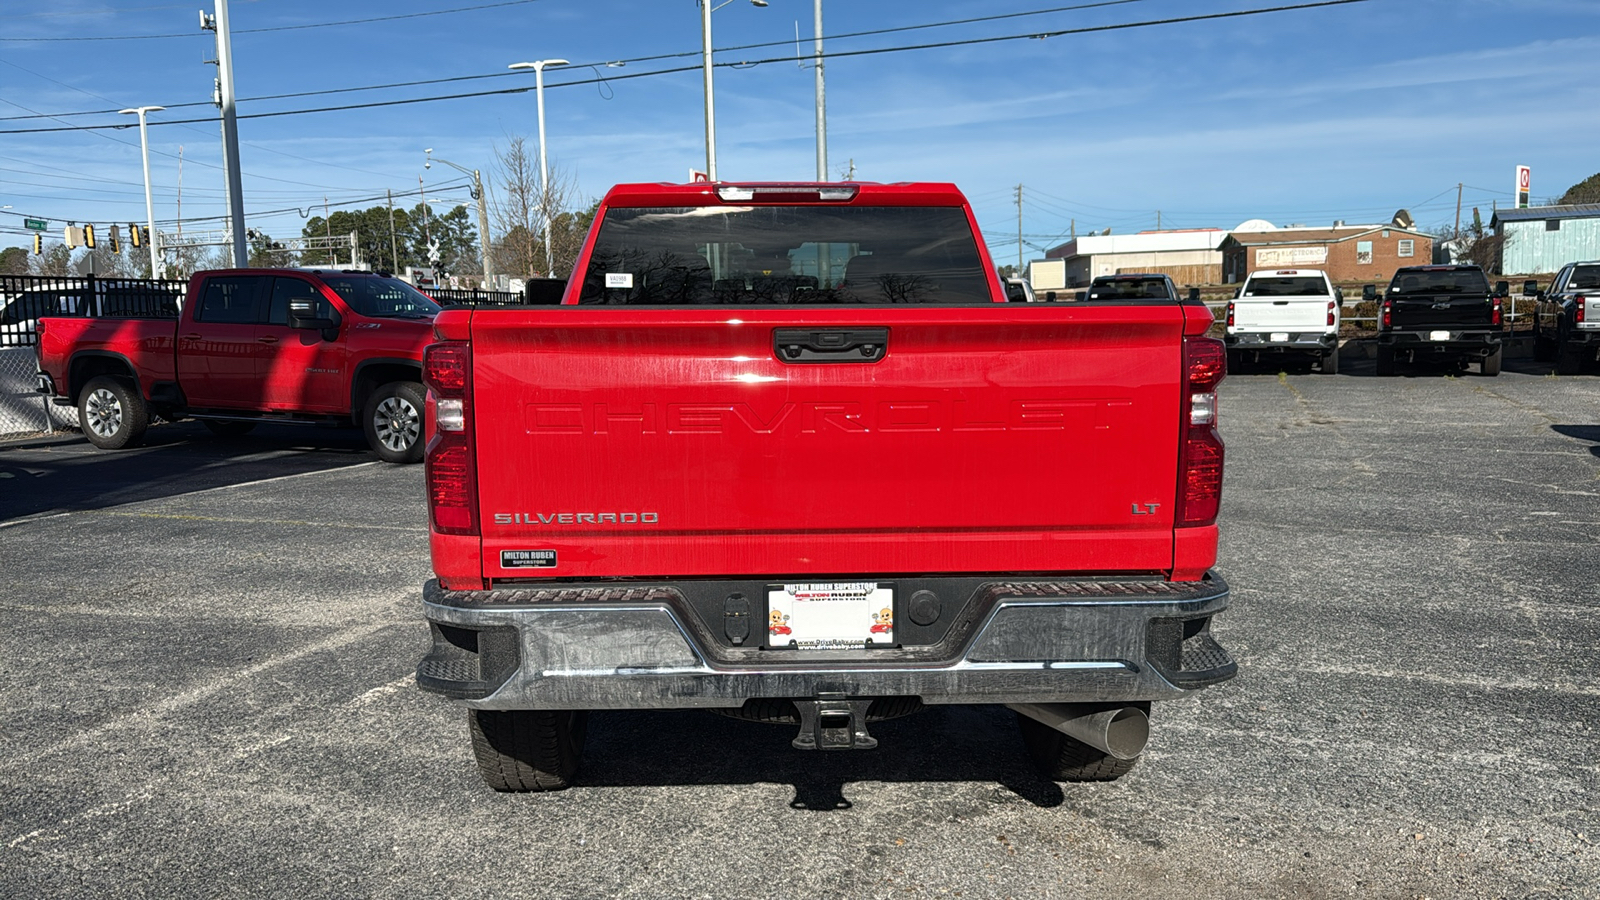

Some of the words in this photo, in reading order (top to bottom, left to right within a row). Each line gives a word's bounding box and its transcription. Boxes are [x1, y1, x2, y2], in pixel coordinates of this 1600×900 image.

[525, 398, 1133, 436] CHEVROLET
[1132, 503, 1160, 515] LT
[494, 512, 659, 524] SILVERADO
[503, 551, 530, 560] MILTON
[530, 551, 554, 559] RUBEN
[784, 583, 809, 591] MILTON
[810, 583, 833, 591] RUBEN
[833, 582, 878, 590] SUPERSTORE
